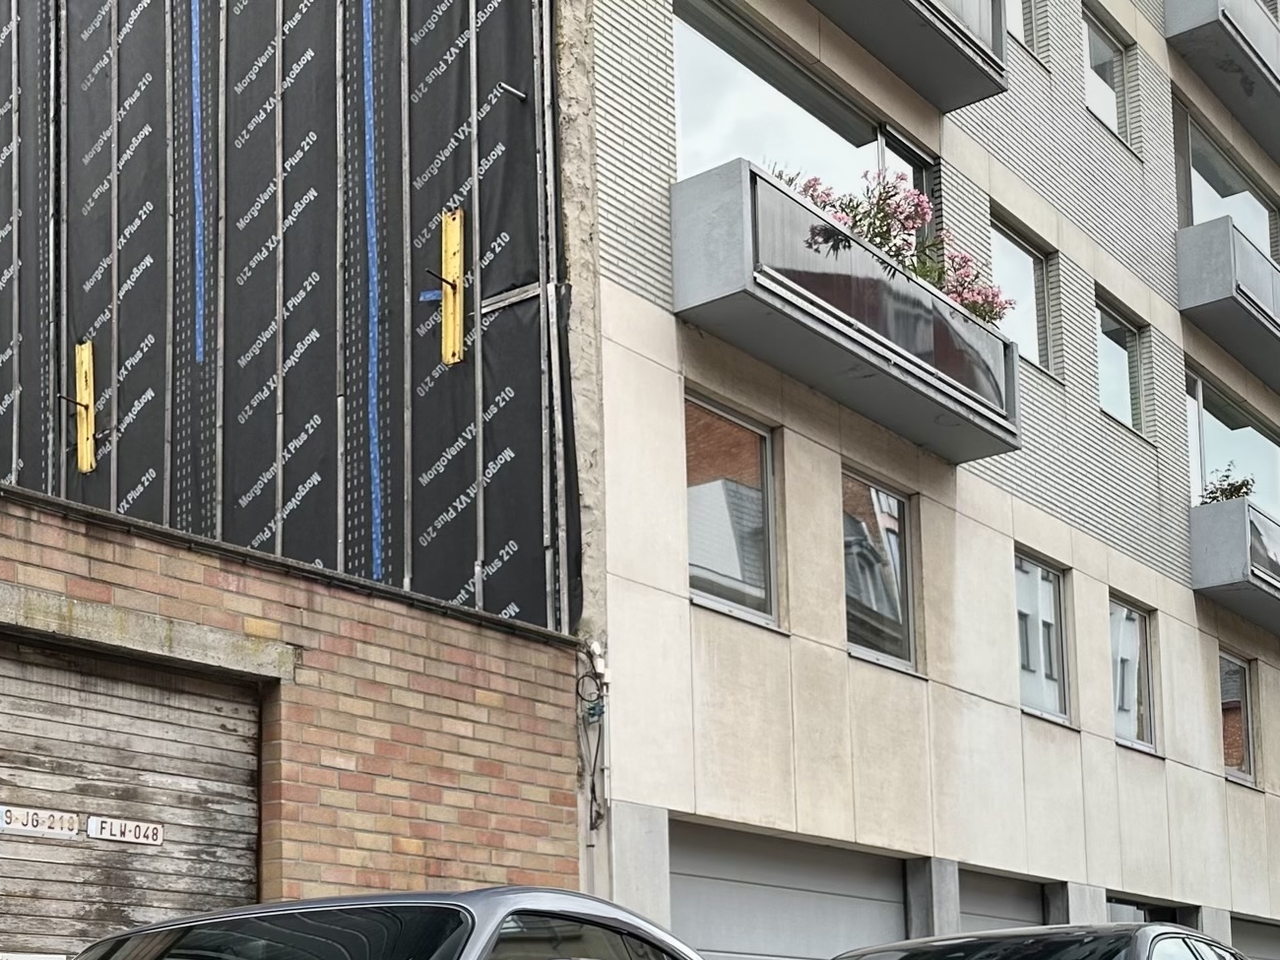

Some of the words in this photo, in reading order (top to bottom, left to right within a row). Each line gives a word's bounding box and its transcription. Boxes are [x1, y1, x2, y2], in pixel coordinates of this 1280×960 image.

[80, 0, 112, 41] MorgoVen
[410, 0, 454, 45] MorgoVen
[455, 0, 502, 48] Morgoent
[234, 46, 275, 94] MorgoVent
[283, 12, 302, 34] Plus
[443, 47, 460, 64] VX
[92, 54, 110, 75] Plus
[278, 48, 315, 92] MorgoVe
[425, 61, 447, 84] Plus
[81, 74, 95, 92] 210
[410, 82, 428, 104] 210
[262, 96, 277, 112] VX
[82, 124, 112, 166] MorgoVe
[124, 90, 140, 110] Plus
[138, 72, 152, 92] 210
[247, 110, 266, 131] Plus
[234, 129, 250, 148] 210
[412, 138, 459, 190] MorgoVent
[454, 122, 472, 140] VX
[459, 142, 506, 196] Morgoent
[92, 180, 110, 200] Plus
[236, 182, 278, 231] MorgoVent
[284, 150, 304, 172] Plus
[300, 131, 318, 152] 210
[82, 198, 95, 216] 210
[282, 187, 318, 232] MorgoVen
[447, 194, 464, 210] VX
[428, 207, 447, 230] lus
[82, 253, 113, 293] MorgoVe
[124, 218, 141, 238] Plus
[138, 201, 154, 220] 210
[266, 235, 280, 251] VX
[414, 228, 431, 248] 210
[249, 248, 269, 268] Plus
[480, 251, 494, 268] lus
[491, 232, 510, 253] 210
[236, 266, 252, 286] 210
[94, 308, 111, 328] Plus
[237, 320, 278, 368] MorgoVent
[286, 289, 306, 311] Plus
[303, 271, 320, 292] 210
[125, 350, 143, 370] Plus
[140, 334, 156, 353] 210
[251, 387, 270, 407] Plus
[416, 376, 434, 396] 210
[237, 405, 253, 424] 210
[288, 432, 308, 454] Plus
[305, 414, 322, 434] 210
[418, 437, 466, 486] MorgoVent
[462, 422, 477, 440] VX
[482, 404, 498, 422] lus
[495, 386, 515, 408] 210
[466, 447, 516, 498] MorgoVnt
[118, 500, 130, 514] VX
[126, 485, 144, 504] Plus
[142, 468, 156, 487] 210
[452, 494, 471, 512] VX
[434, 507, 456, 529] Plus
[252, 528, 272, 548] Plus
[418, 526, 437, 547] 210
[482, 558, 502, 581] Plus
[499, 540, 518, 561] 210
